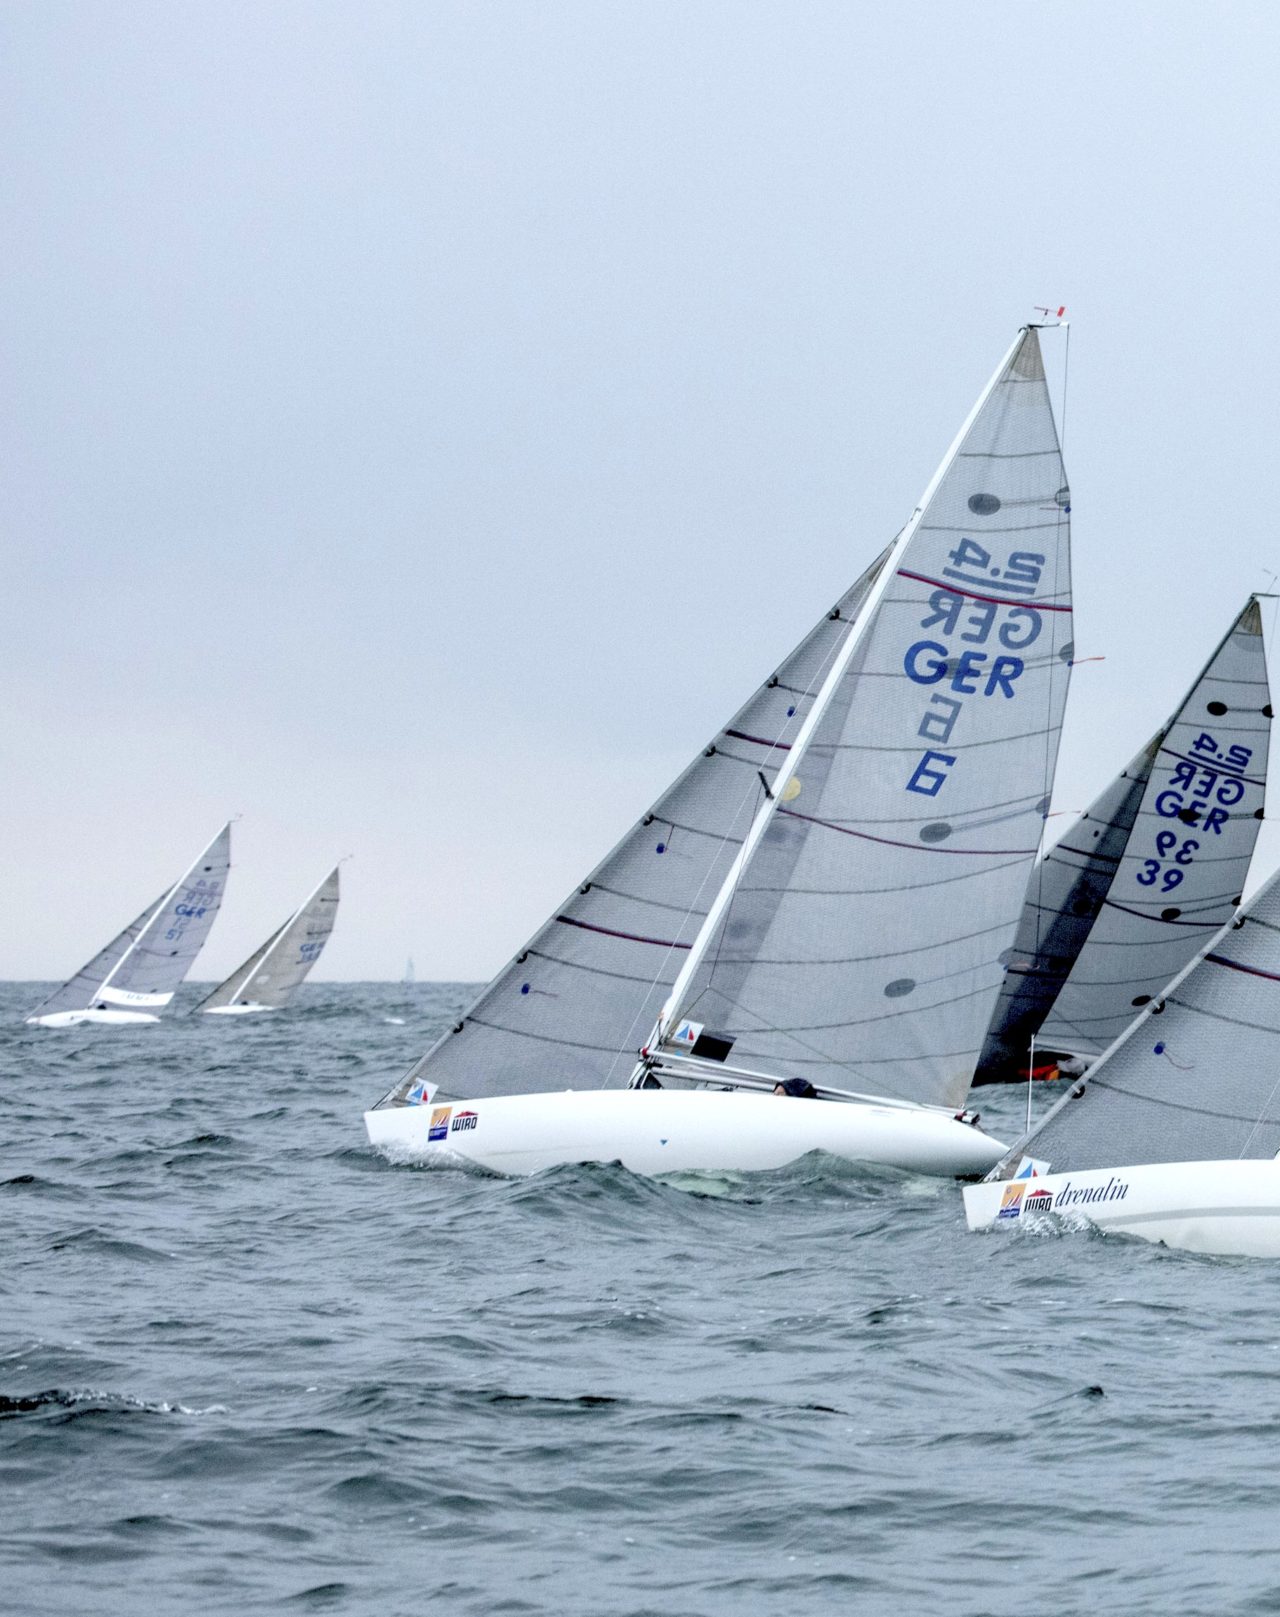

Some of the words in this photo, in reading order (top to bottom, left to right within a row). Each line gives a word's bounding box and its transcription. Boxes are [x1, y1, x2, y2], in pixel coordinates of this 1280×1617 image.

[904, 640, 1024, 698] GER
[905, 750, 957, 797] 6
[1155, 791, 1229, 834] GER
[1136, 859, 1184, 892] 39
[452, 1117, 478, 1132] WIRO
[1054, 1177, 1130, 1208] drenalin
